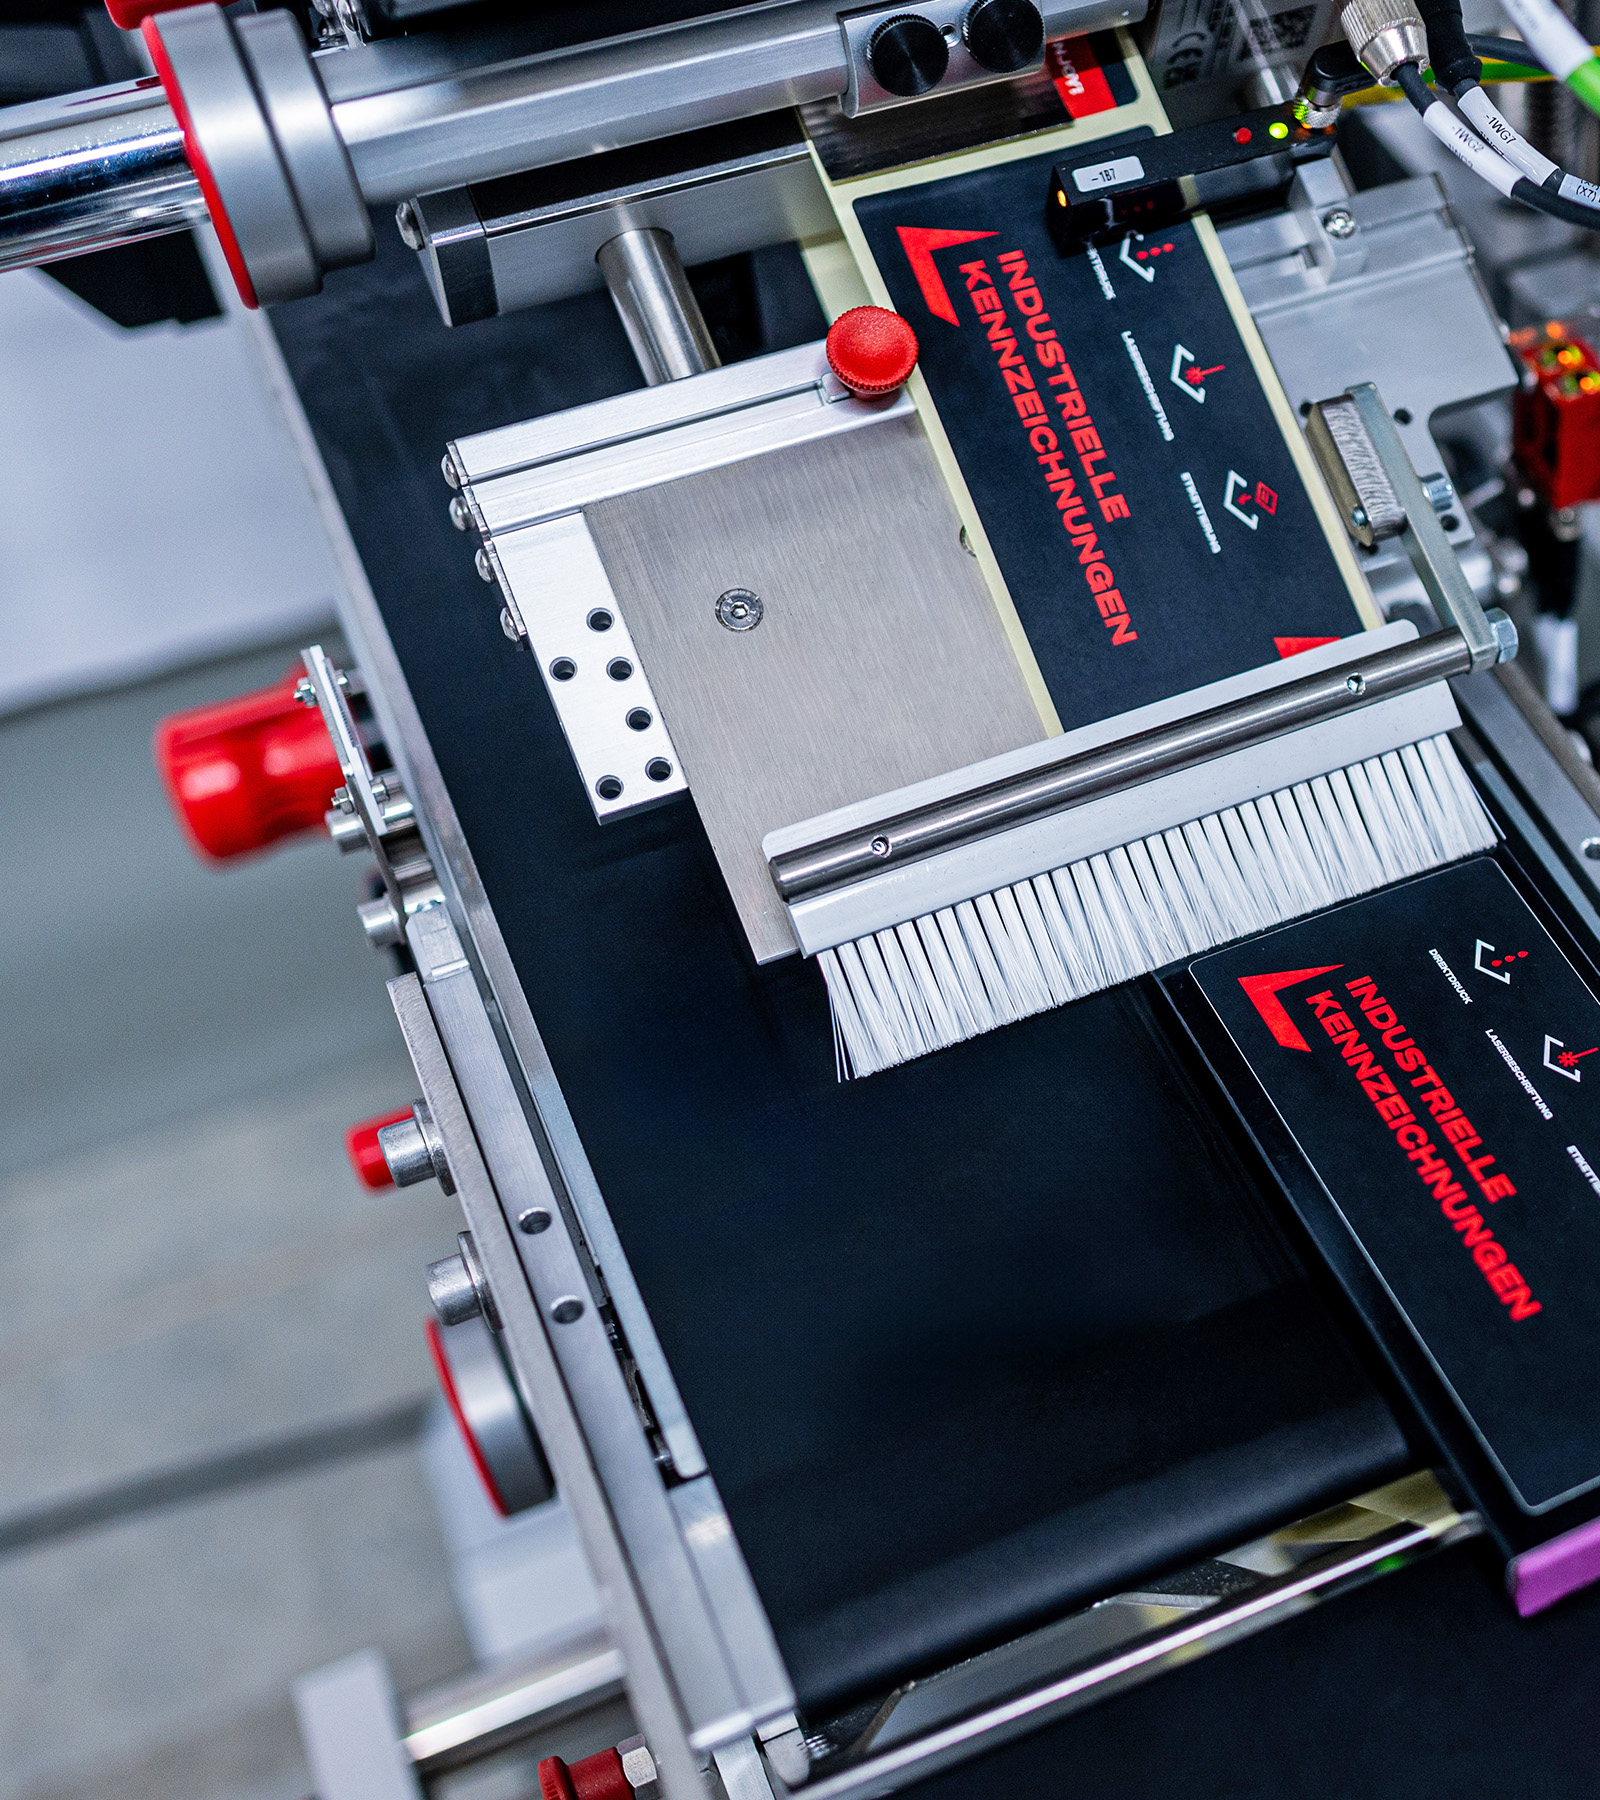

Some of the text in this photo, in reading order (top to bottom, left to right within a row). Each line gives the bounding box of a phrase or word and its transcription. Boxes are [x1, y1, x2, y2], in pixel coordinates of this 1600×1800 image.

[1451, 126, 1485, 153] -1WG2
[1484, 114, 1517, 145] -1WG7
[1091, 168, 1117, 183] -1B7
[1576, 184, 1597, 203] (X7)
[997, 249, 1131, 523] INDUSTRIELLE
[1120, 330, 1175, 442] LASERBESCHRIFTUNG
[958, 259, 1139, 646] KENNZEICHNUNGEN
[1179, 471, 1222, 554] ETIKETTIERUNG
[1428, 948, 1474, 1005] DIREKTDRUCK
[1345, 975, 1517, 1203] INDUSTRIELLE
[1484, 1028, 1554, 1120] LASERBESCHRIFTUNG
[1305, 989, 1542, 1321] KENNZEICHNUNGEN
